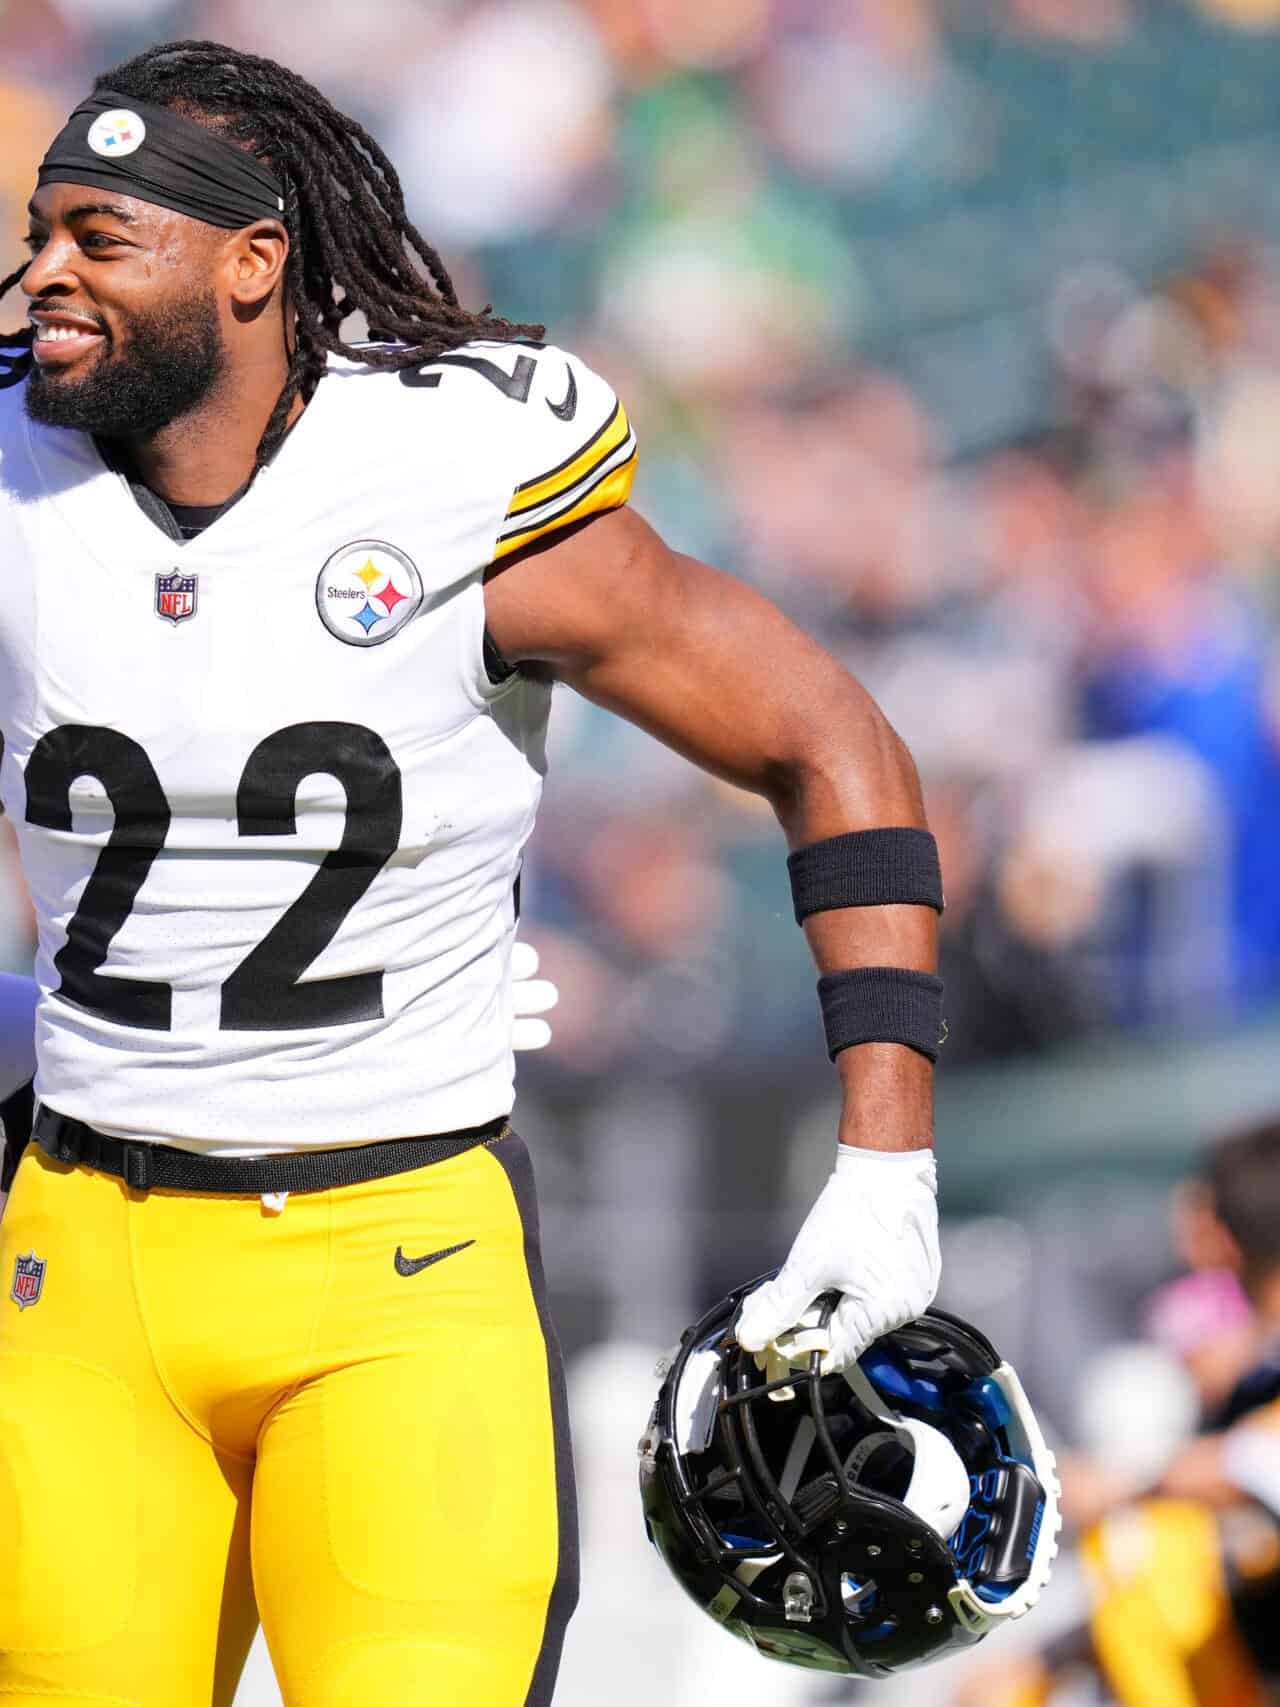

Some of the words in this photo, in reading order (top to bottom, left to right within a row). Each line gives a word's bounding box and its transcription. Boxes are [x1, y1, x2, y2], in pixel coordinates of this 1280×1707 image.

[160, 592, 192, 616] NFL
[327, 586, 366, 599] Steelers
[23, 720, 402, 1031] 22
[16, 1275, 38, 1297] NFL
